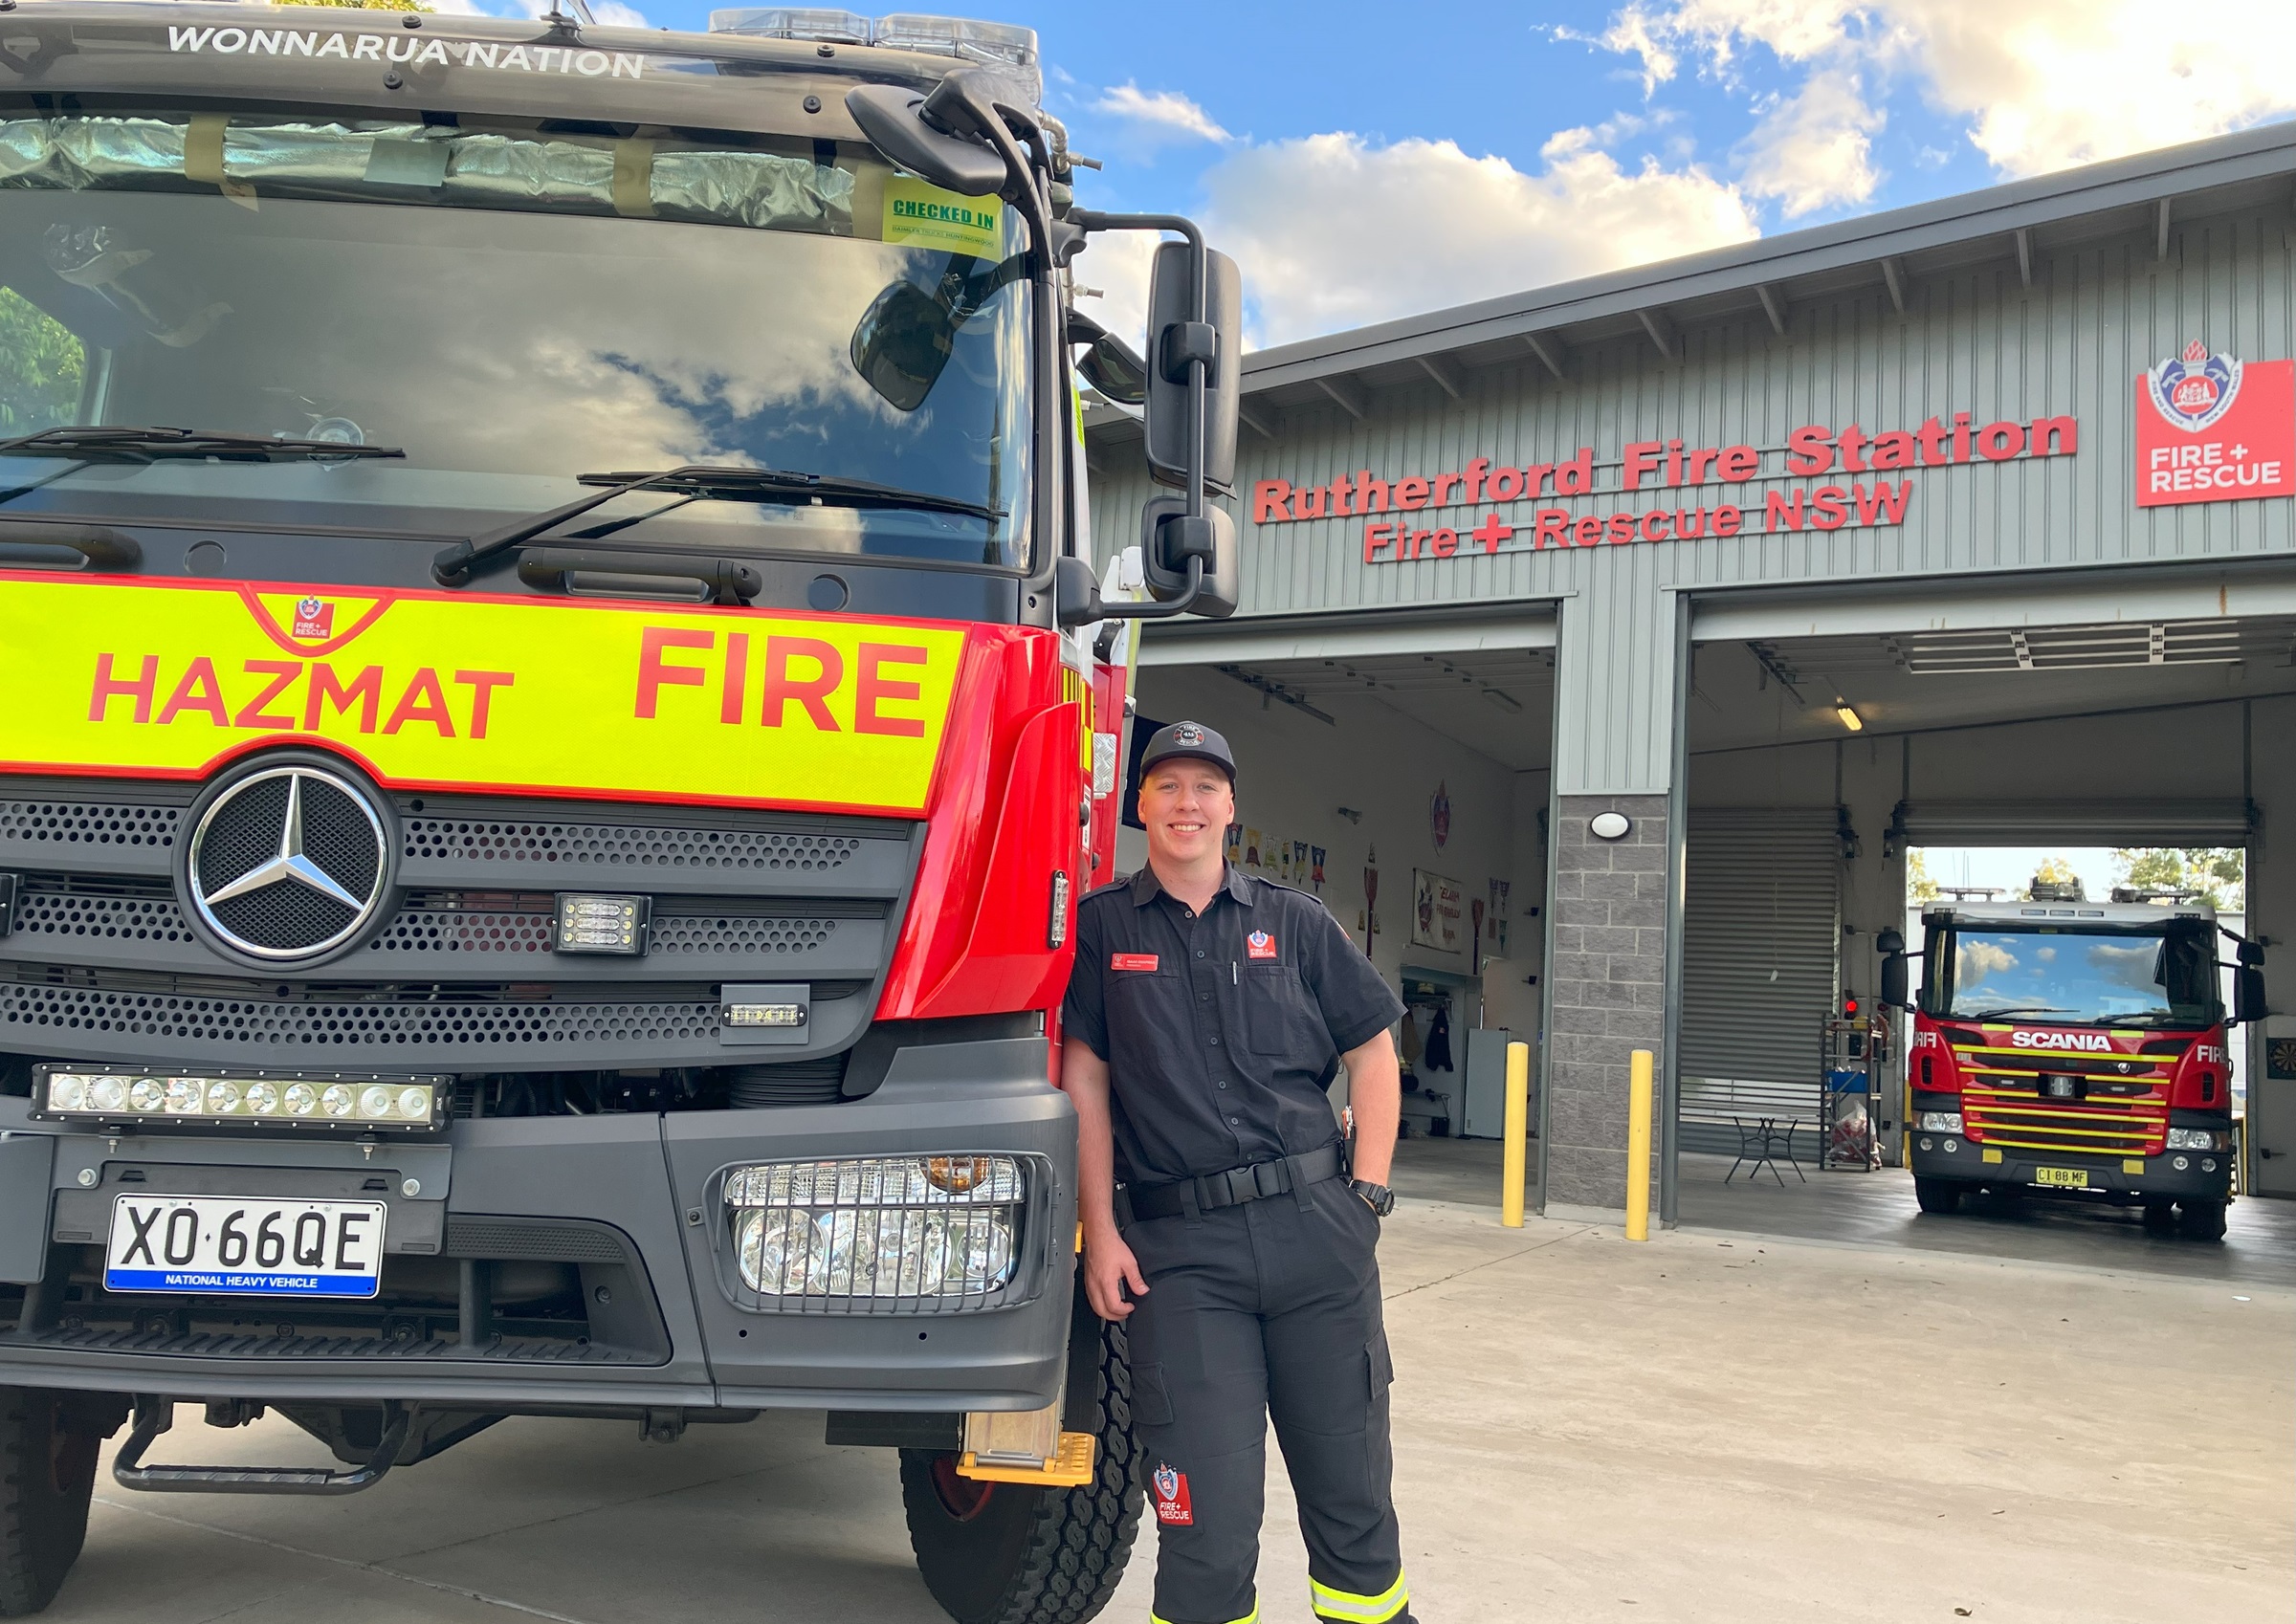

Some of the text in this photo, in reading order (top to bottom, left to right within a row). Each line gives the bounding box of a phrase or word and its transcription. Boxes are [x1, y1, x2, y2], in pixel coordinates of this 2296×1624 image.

[167, 26, 646, 79] WONNARUA NATION
[893, 199, 994, 229] CHECKED IN
[945, 231, 994, 248] HUNTINGWOOD
[1253, 412, 2078, 524] Rutherford Fire Station
[2151, 442, 2223, 471] FIRE
[2151, 460, 2282, 494] RESCUE
[1363, 479, 1913, 564] Fire + Rescue NSW
[86, 651, 516, 740] HAZMAT
[633, 625, 929, 738] FIRE
[2012, 1031, 2112, 1052] SCANIA
[165, 1274, 319, 1289] NATIONAL HEAVY VEHICLE
[1159, 1511, 1189, 1520] RESCUE
